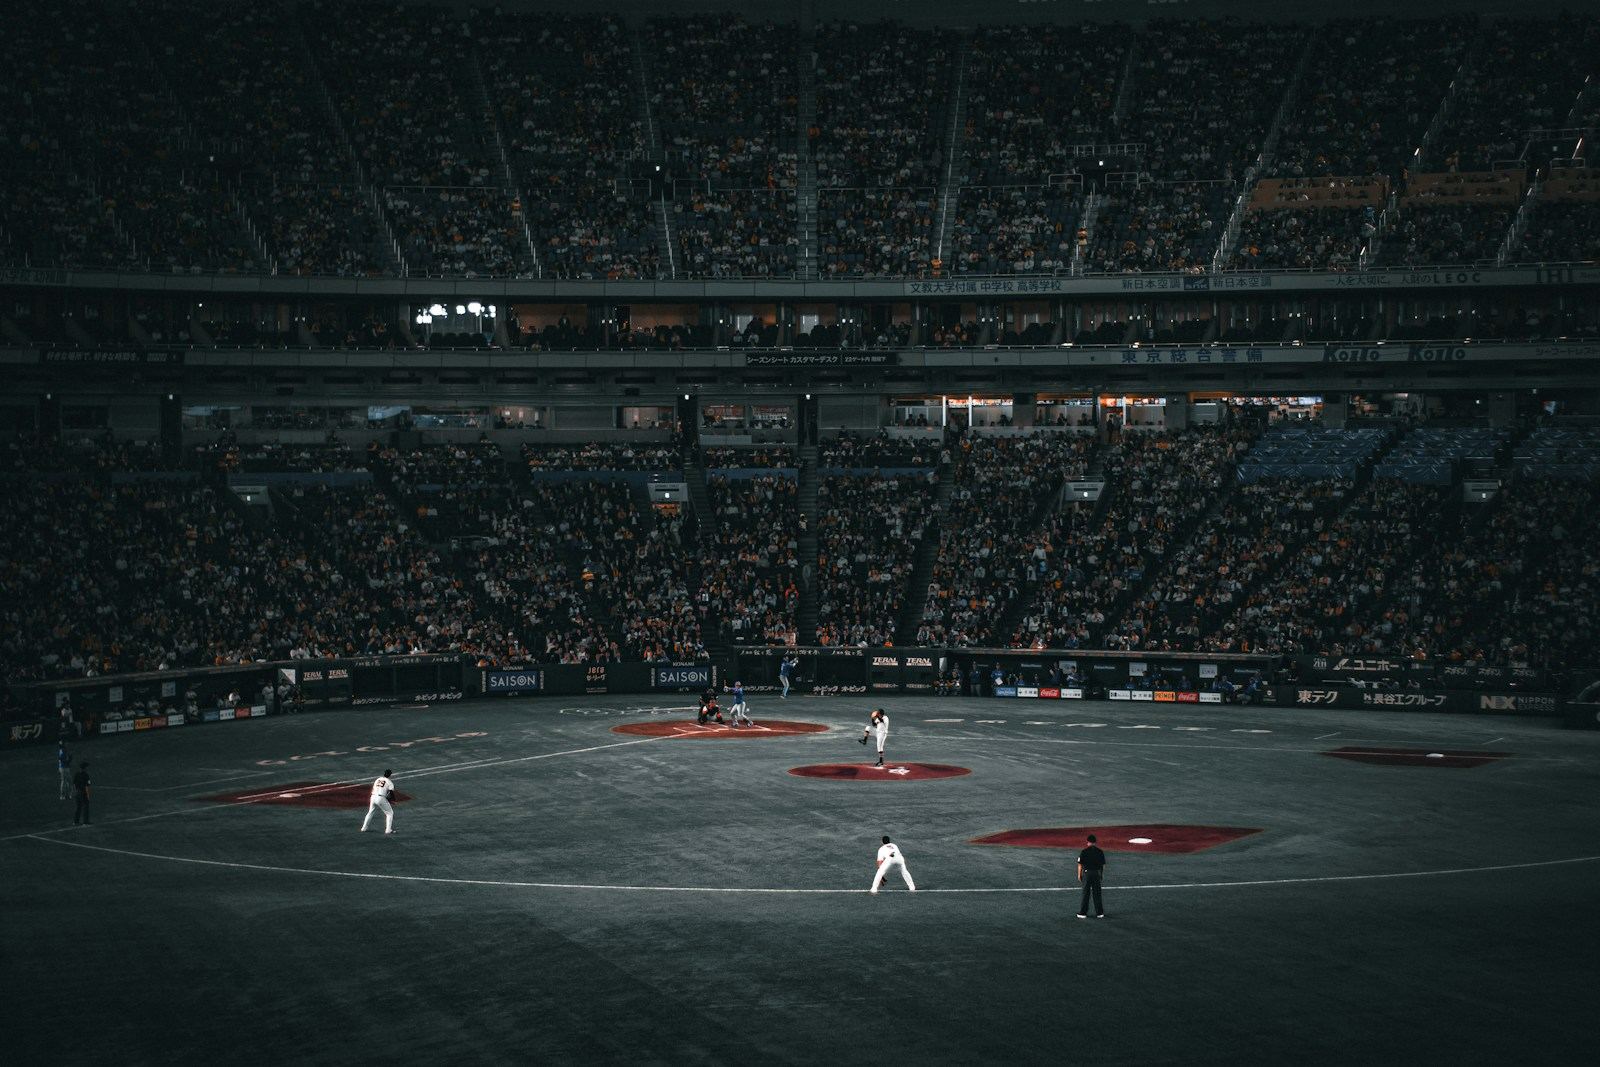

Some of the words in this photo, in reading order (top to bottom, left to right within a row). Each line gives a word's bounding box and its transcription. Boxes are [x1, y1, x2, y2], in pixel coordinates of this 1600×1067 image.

[1434, 272, 1481, 285] LEOC
[911, 281, 977, 294] 文教大学付属
[980, 281, 1014, 292] 中学校
[1017, 280, 1062, 292] 高等学校
[746, 355, 788, 364] シーズンシート
[790, 355, 838, 364] カスタマーデスク
[1121, 349, 1265, 363] 東京総合警備
[490, 674, 536, 688] SAISON
[660, 671, 708, 683] SAISON
[1297, 690, 1339, 704] 東テク
[1373, 693, 1447, 706] 長谷工グループ
[1518, 696, 1556, 705] NIPPON
